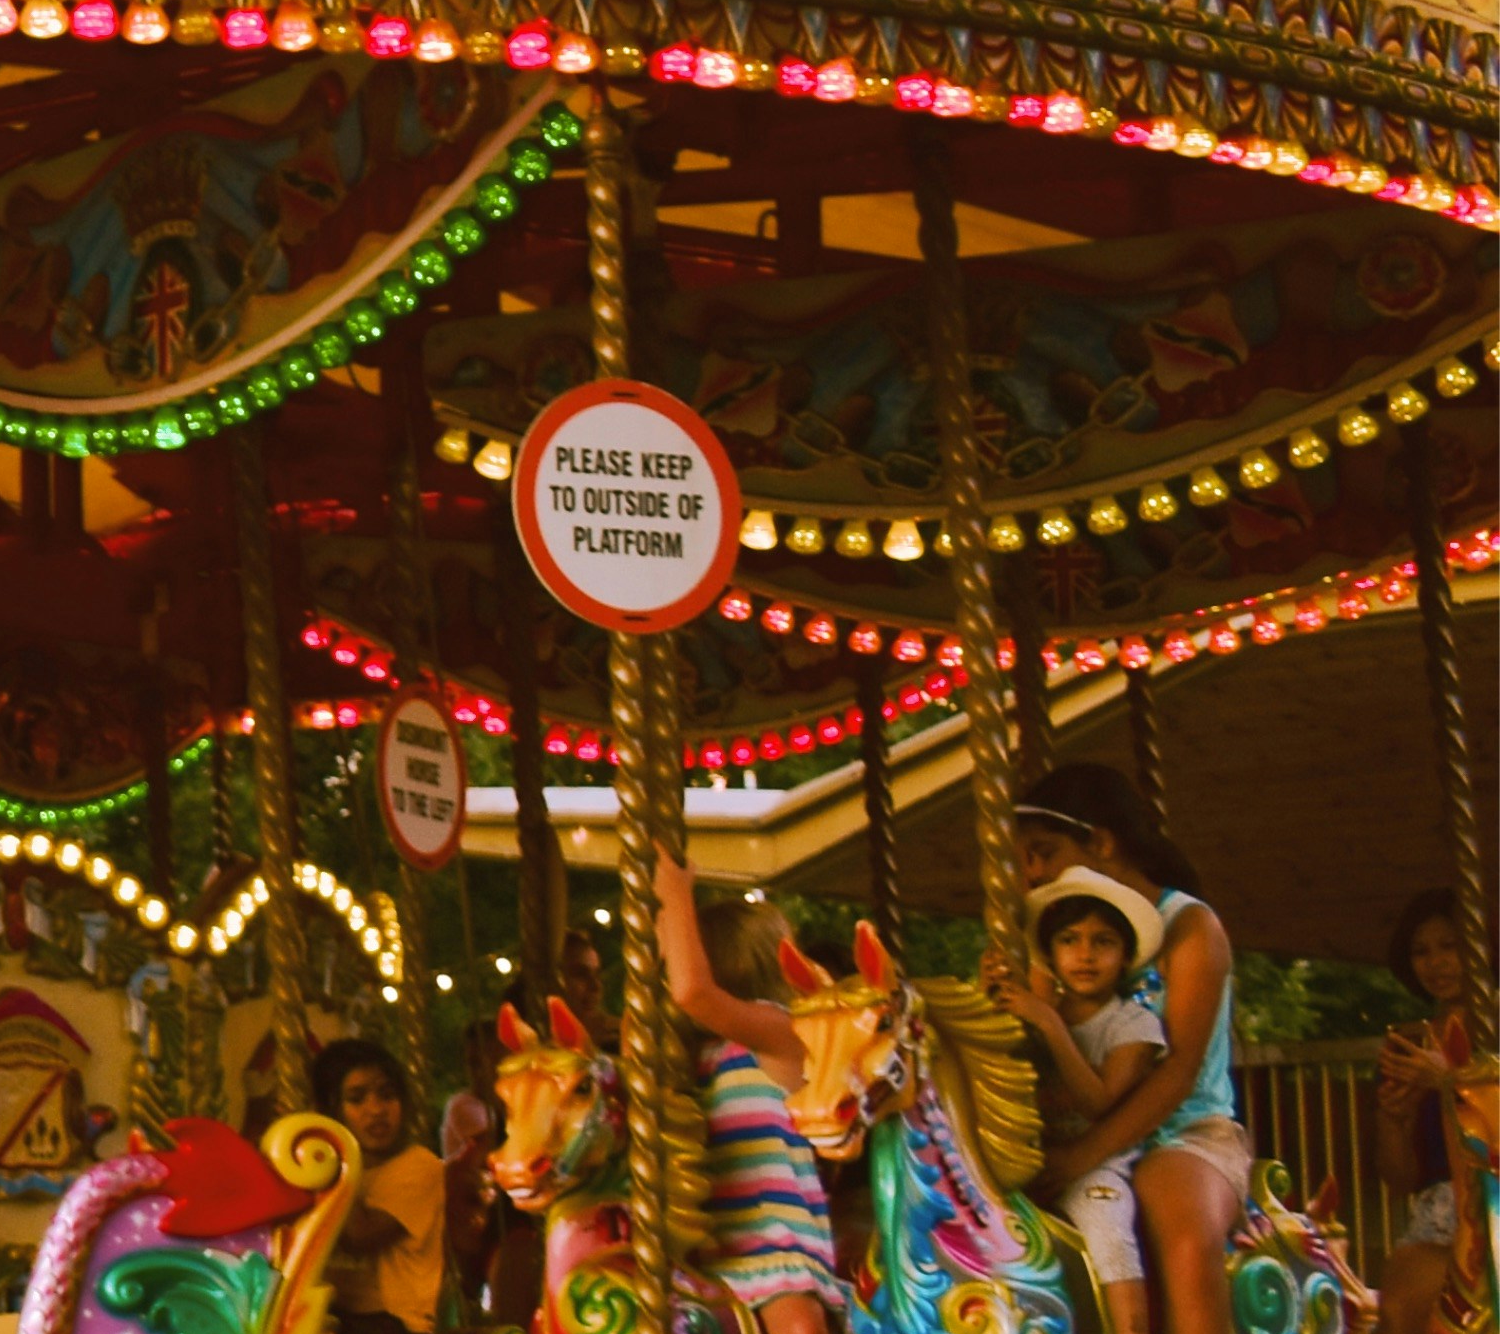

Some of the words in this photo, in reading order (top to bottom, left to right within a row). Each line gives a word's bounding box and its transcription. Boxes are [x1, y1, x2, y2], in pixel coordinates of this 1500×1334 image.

[555, 446, 633, 477] PLEASE
[641, 452, 693, 481] KEEP
[549, 485, 576, 512] TO
[583, 487, 670, 518] OUTSIDE
[678, 494, 704, 521] OF
[573, 526, 684, 558] PLATFORM
